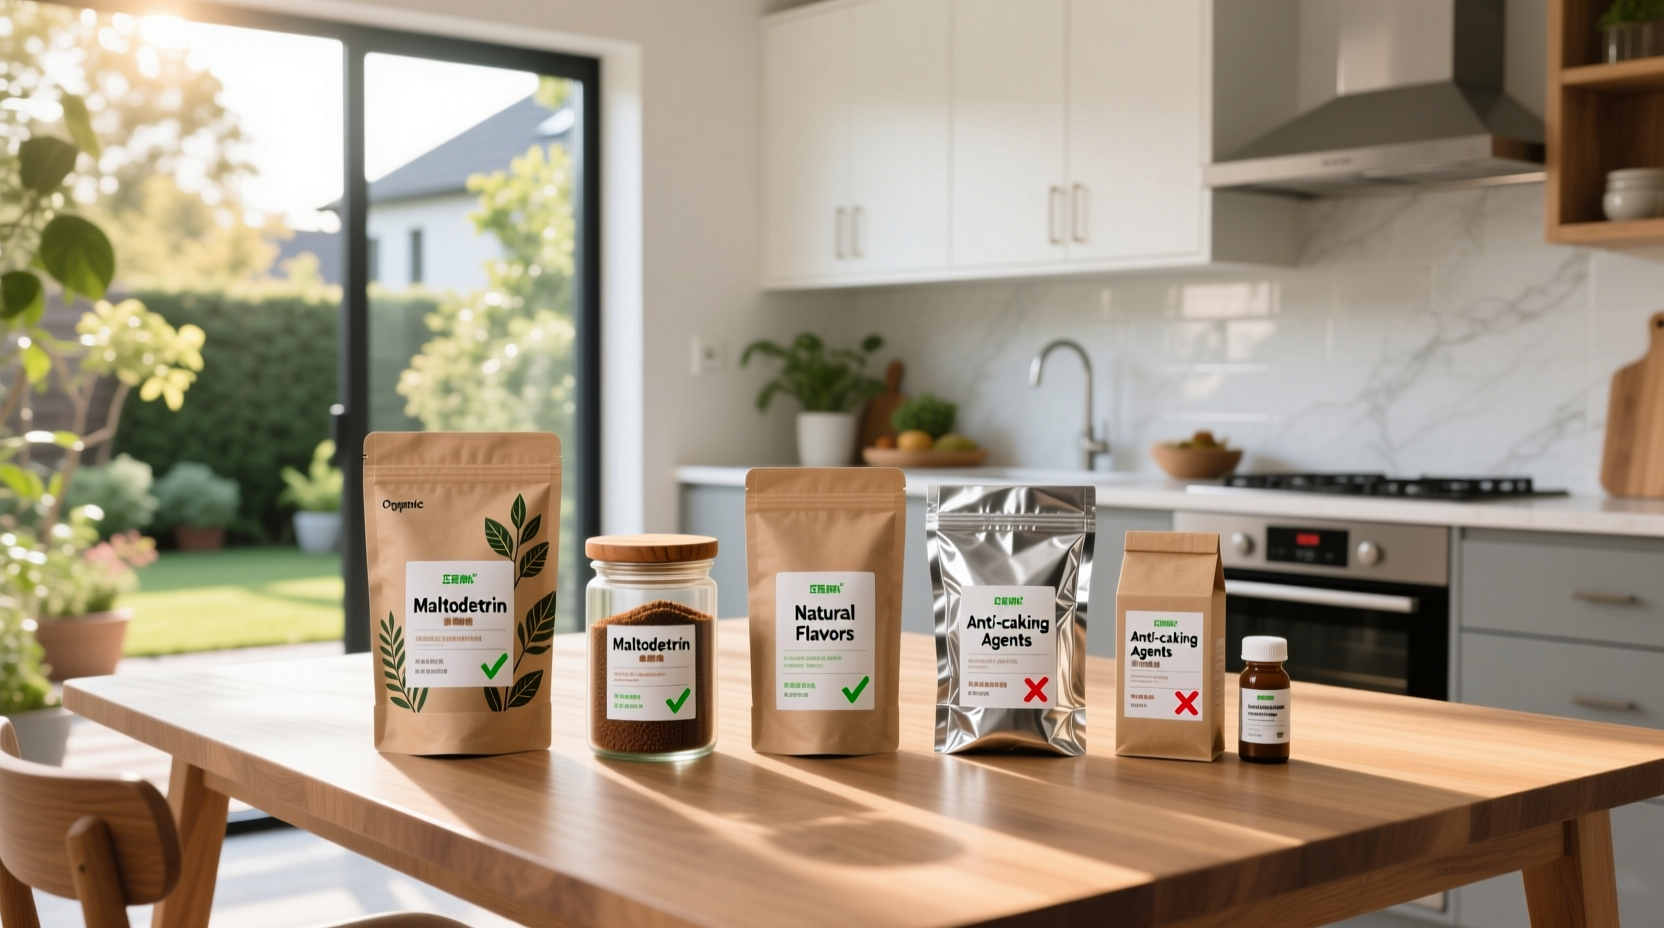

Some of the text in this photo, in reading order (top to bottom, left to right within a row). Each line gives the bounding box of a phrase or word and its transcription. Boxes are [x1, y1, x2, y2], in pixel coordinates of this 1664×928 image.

[413, 596, 507, 613] Maltodetrin
[795, 604, 855, 621] Natural
[966, 613, 1050, 634] Anti-caking
[796, 625, 855, 641] Flavors
[981, 632, 1033, 650] Agents
[1130, 630, 1198, 648] Anti-caking
[613, 637, 690, 651] Maltodetrin
[1130, 645, 1173, 660] Agents
